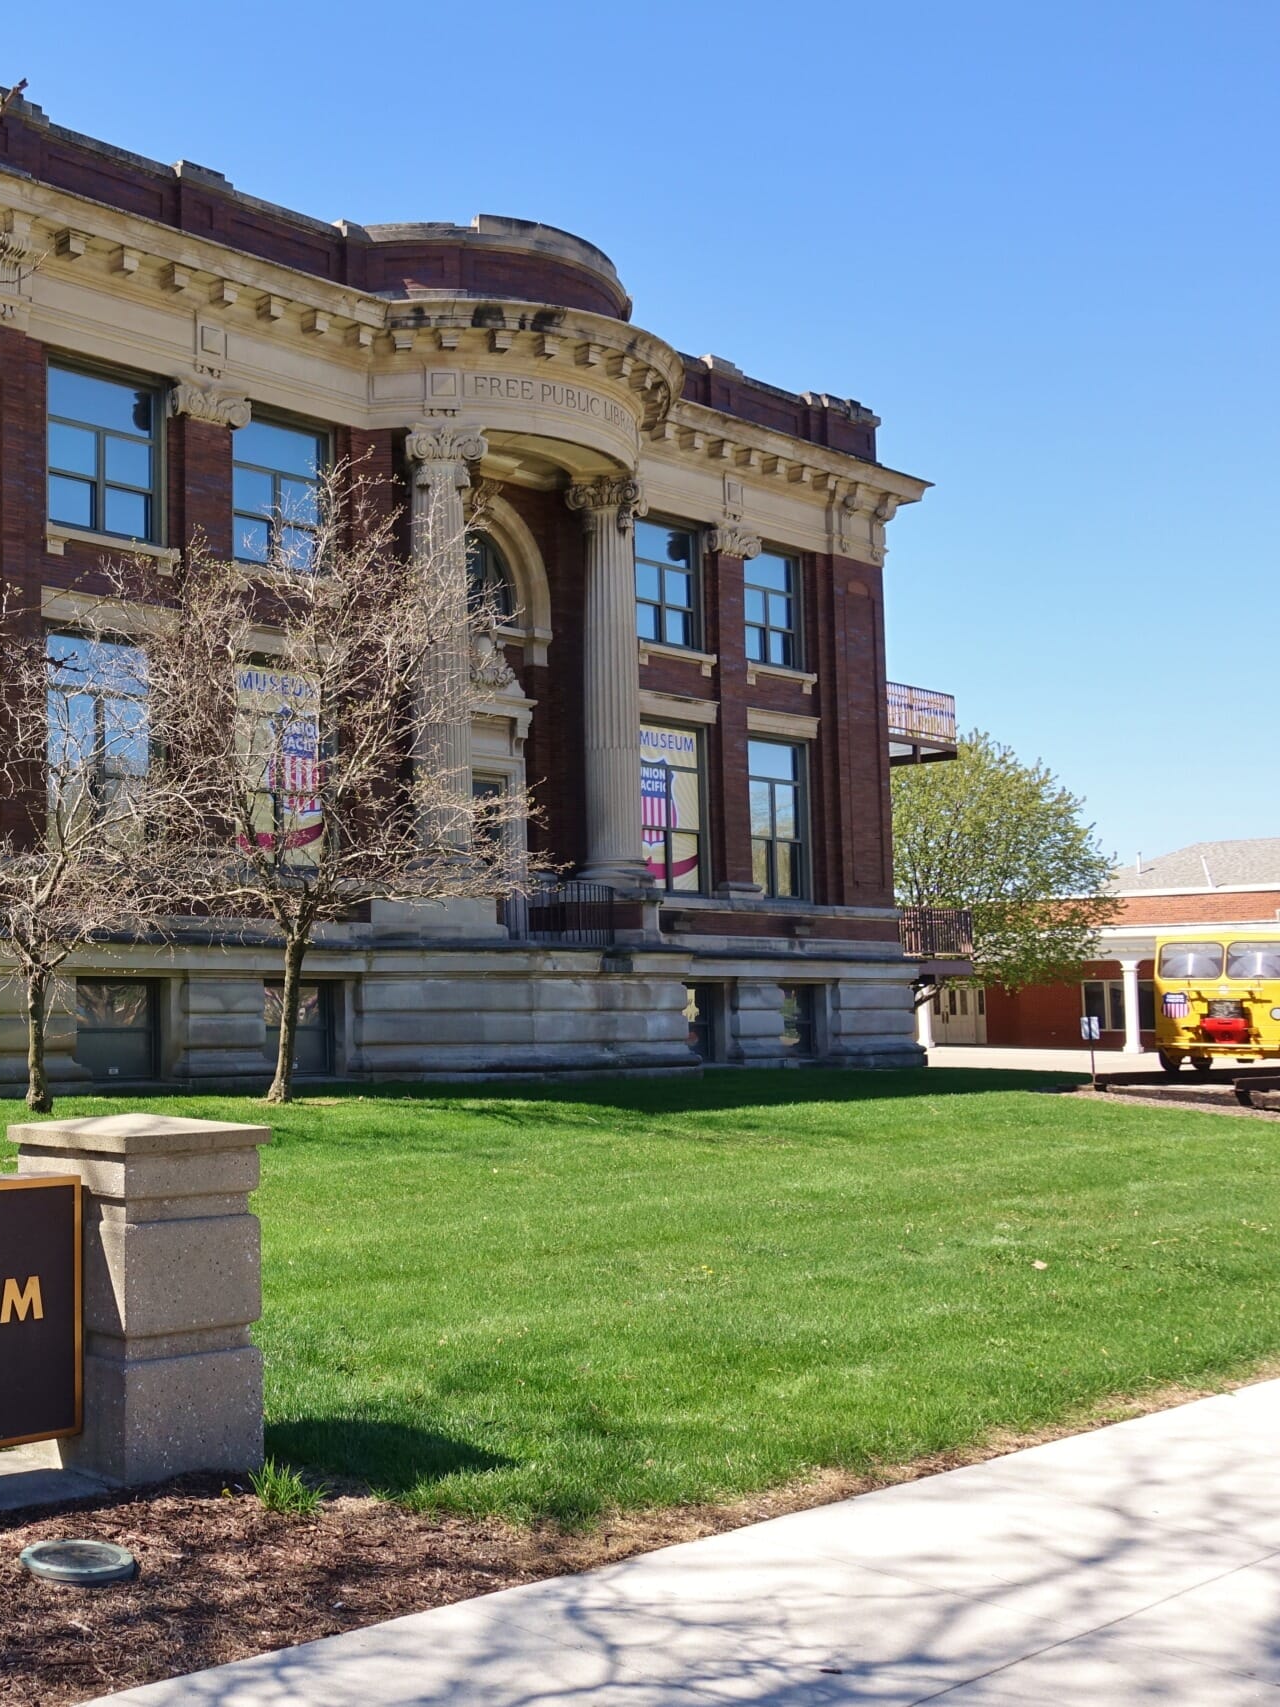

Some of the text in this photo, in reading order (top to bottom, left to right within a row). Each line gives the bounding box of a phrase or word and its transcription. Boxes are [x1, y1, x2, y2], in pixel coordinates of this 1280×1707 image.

[474, 376, 634, 431] FREE PUBLIC LIBR
[639, 730, 694, 752] MUSEUM
[641, 779, 666, 792] ACIFI
